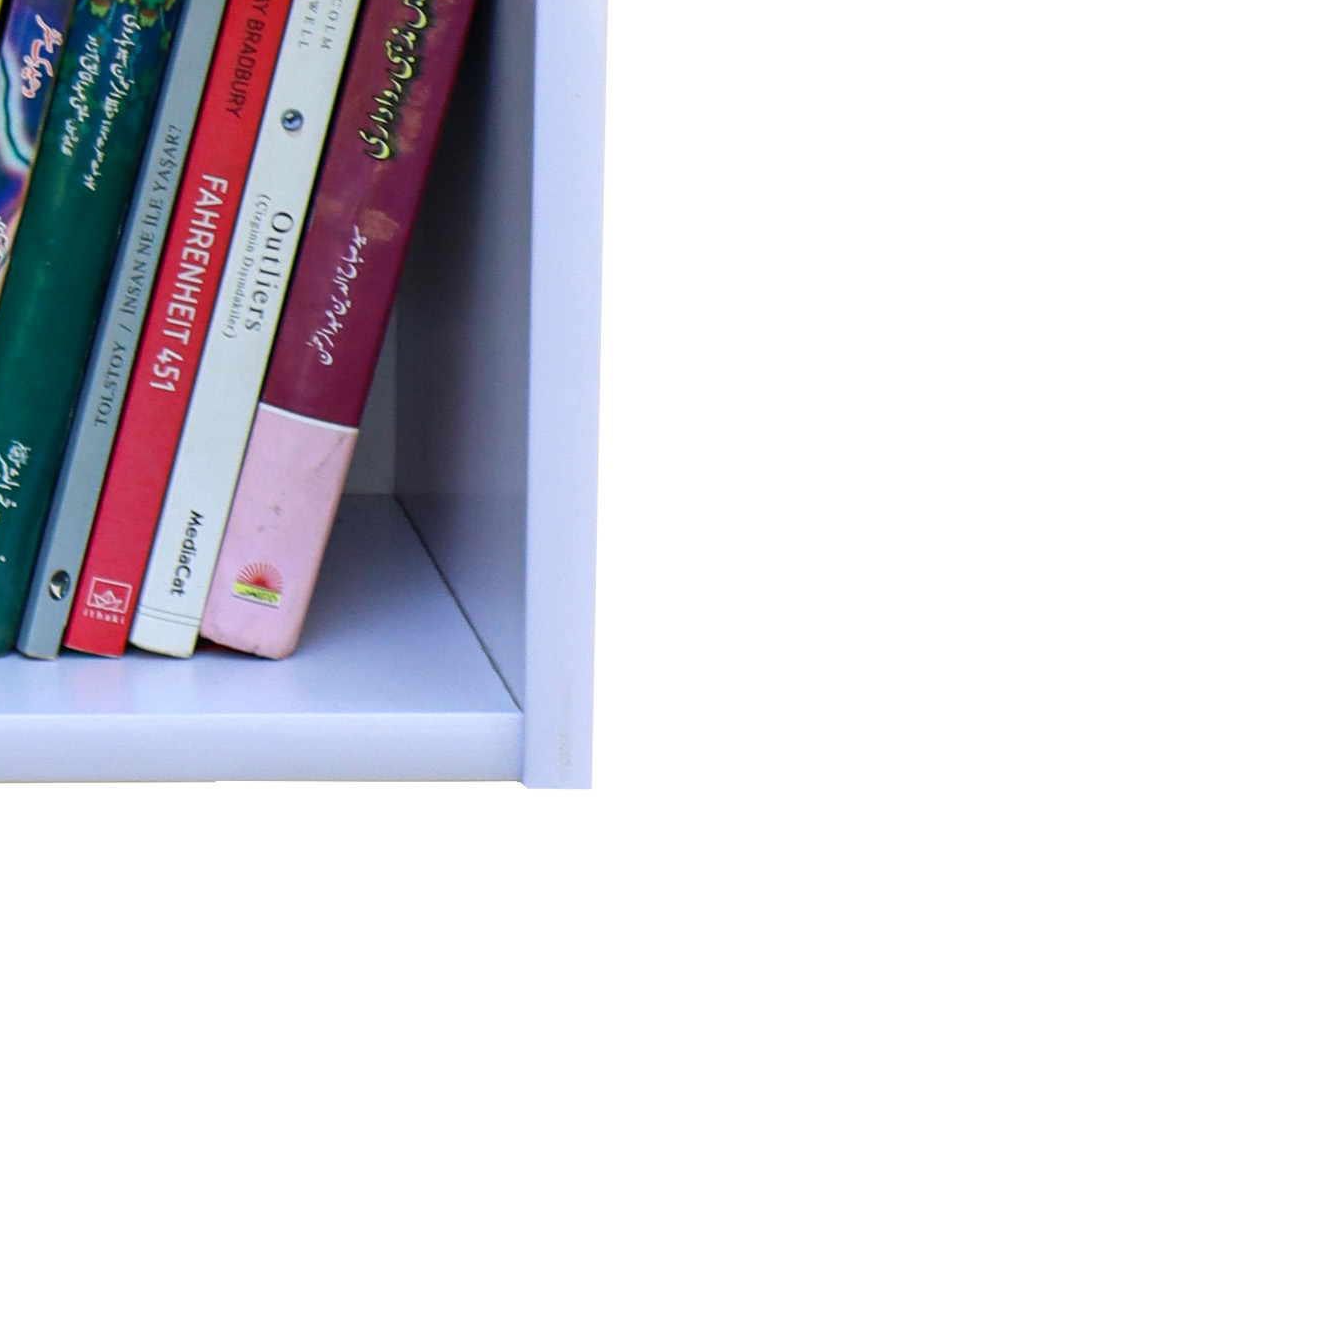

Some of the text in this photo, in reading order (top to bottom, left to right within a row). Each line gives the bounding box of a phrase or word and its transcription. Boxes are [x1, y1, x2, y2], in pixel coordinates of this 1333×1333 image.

[226, 18, 264, 118] BRADBURY
[385, 27, 417, 79] مذہبی
[152, 124, 181, 194] YAŞAR?
[359, 79, 402, 159] رواداری
[136, 232, 155, 254] NE
[141, 198, 162, 226] İLE
[119, 259, 147, 315] İNSAN
[149, 175, 228, 392] FAHRENHEIT 451
[222, 193, 271, 339] (Çizginin Dışındakiler)
[245, 211, 294, 330] Outliers
[94, 341, 127, 425] TOLSTOY
[170, 510, 203, 595] MediaCat
[83, 609, 125, 624] ithaki
